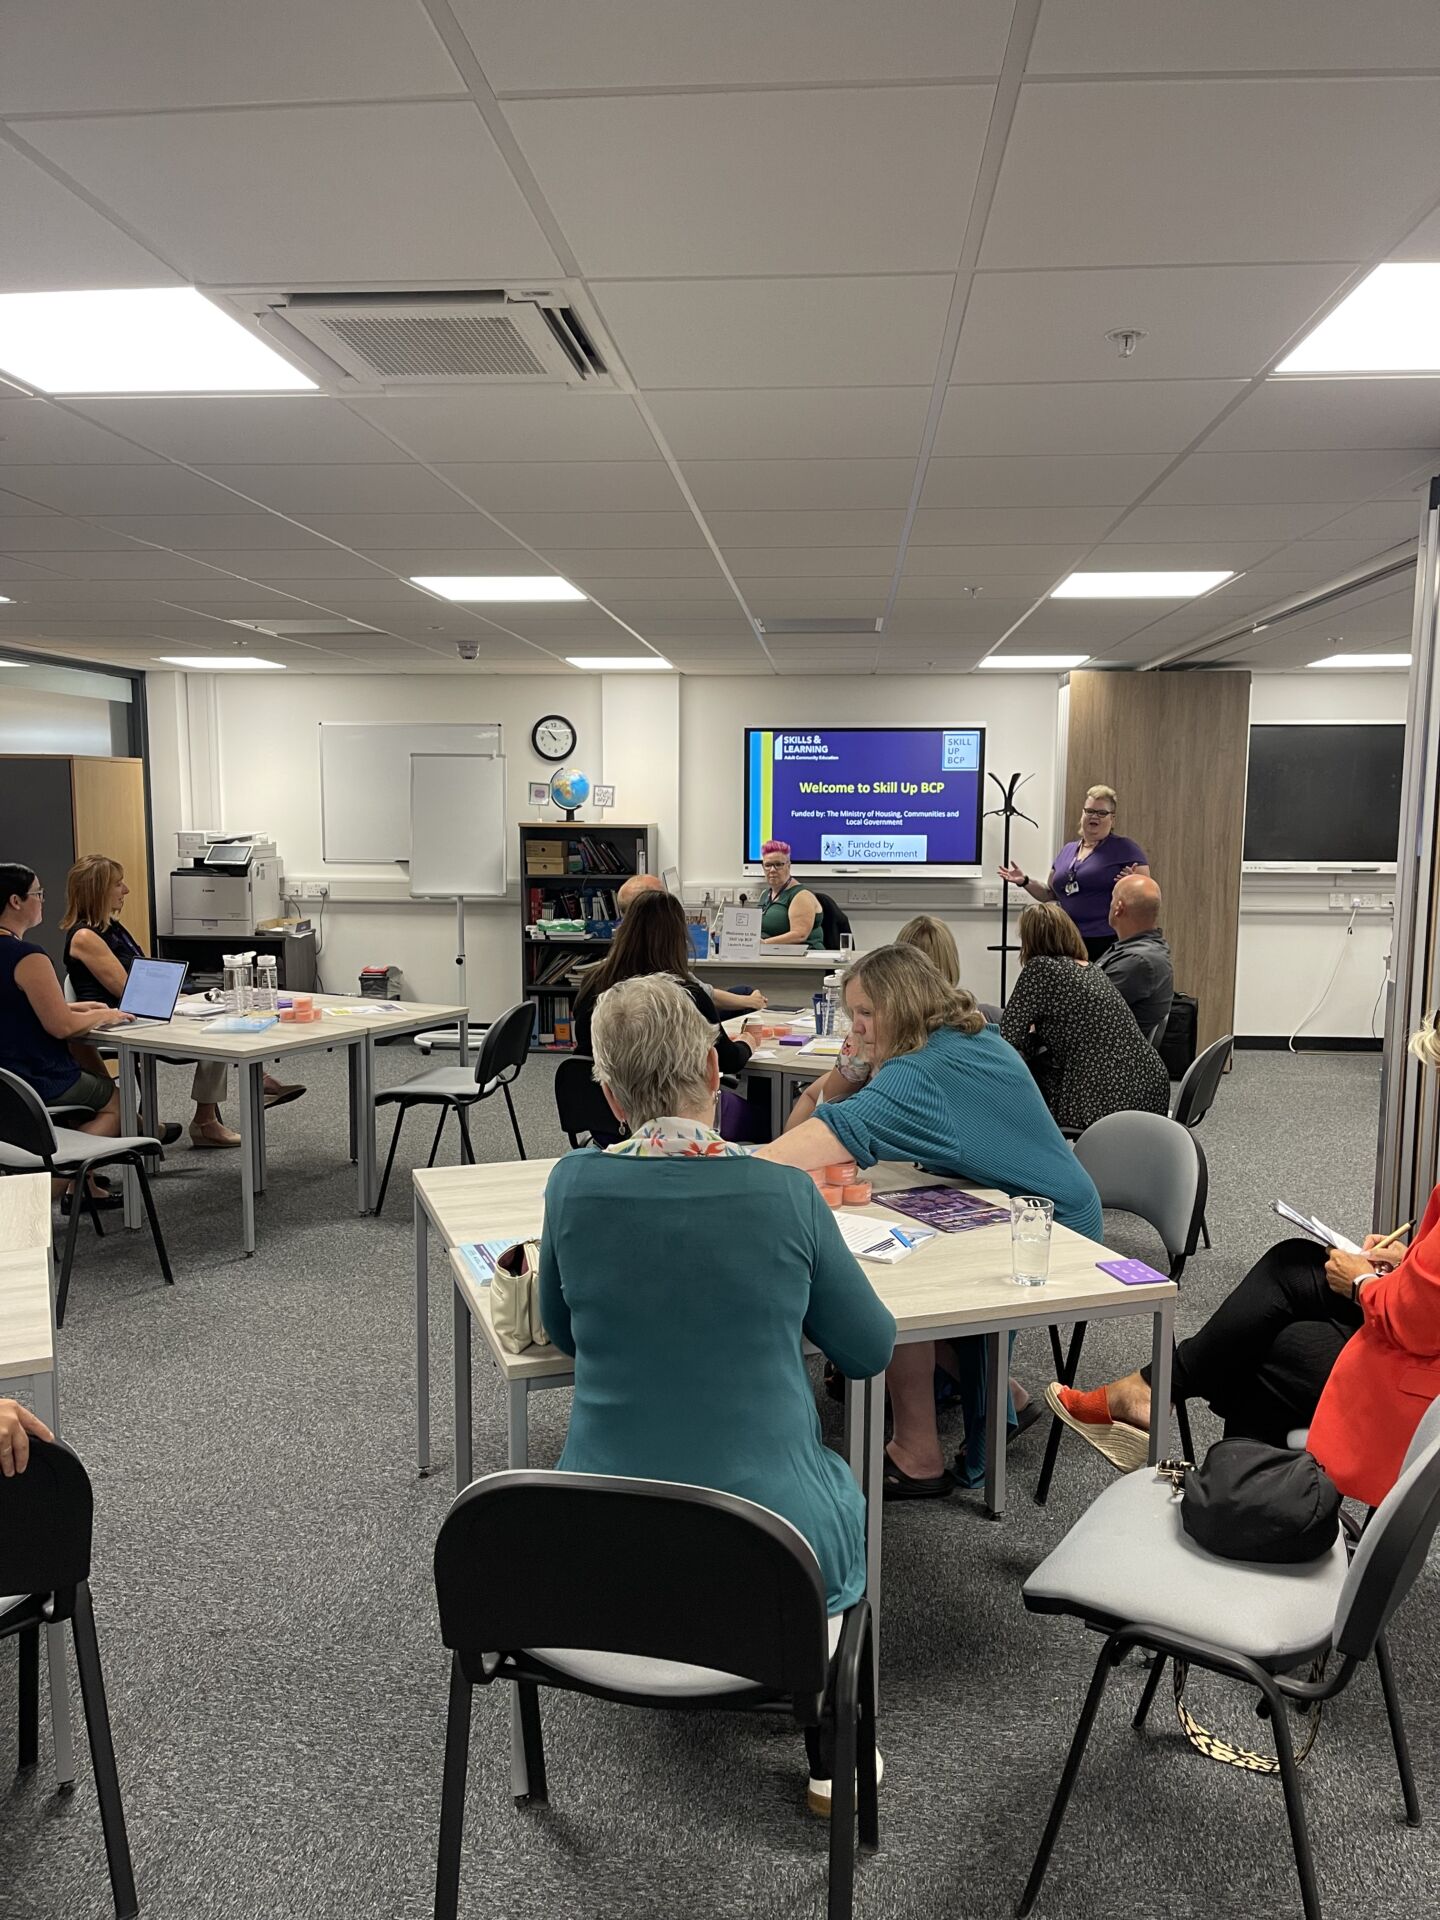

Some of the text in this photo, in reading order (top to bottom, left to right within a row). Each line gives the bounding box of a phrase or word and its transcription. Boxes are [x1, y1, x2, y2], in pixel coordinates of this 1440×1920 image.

[783, 735, 821, 744] SKILLS &
[947, 738, 972, 746] SKILL
[783, 745, 828, 753] LEARNING
[947, 747, 960, 755] UP
[947, 756, 965, 764] BCP
[799, 782, 945, 796] Welcome to Skill Up BCP
[791, 810, 959, 819] Funded by: The Ministry of Housing, Communities and
[847, 840, 895, 851] Funded by
[847, 850, 918, 858] UK Government
